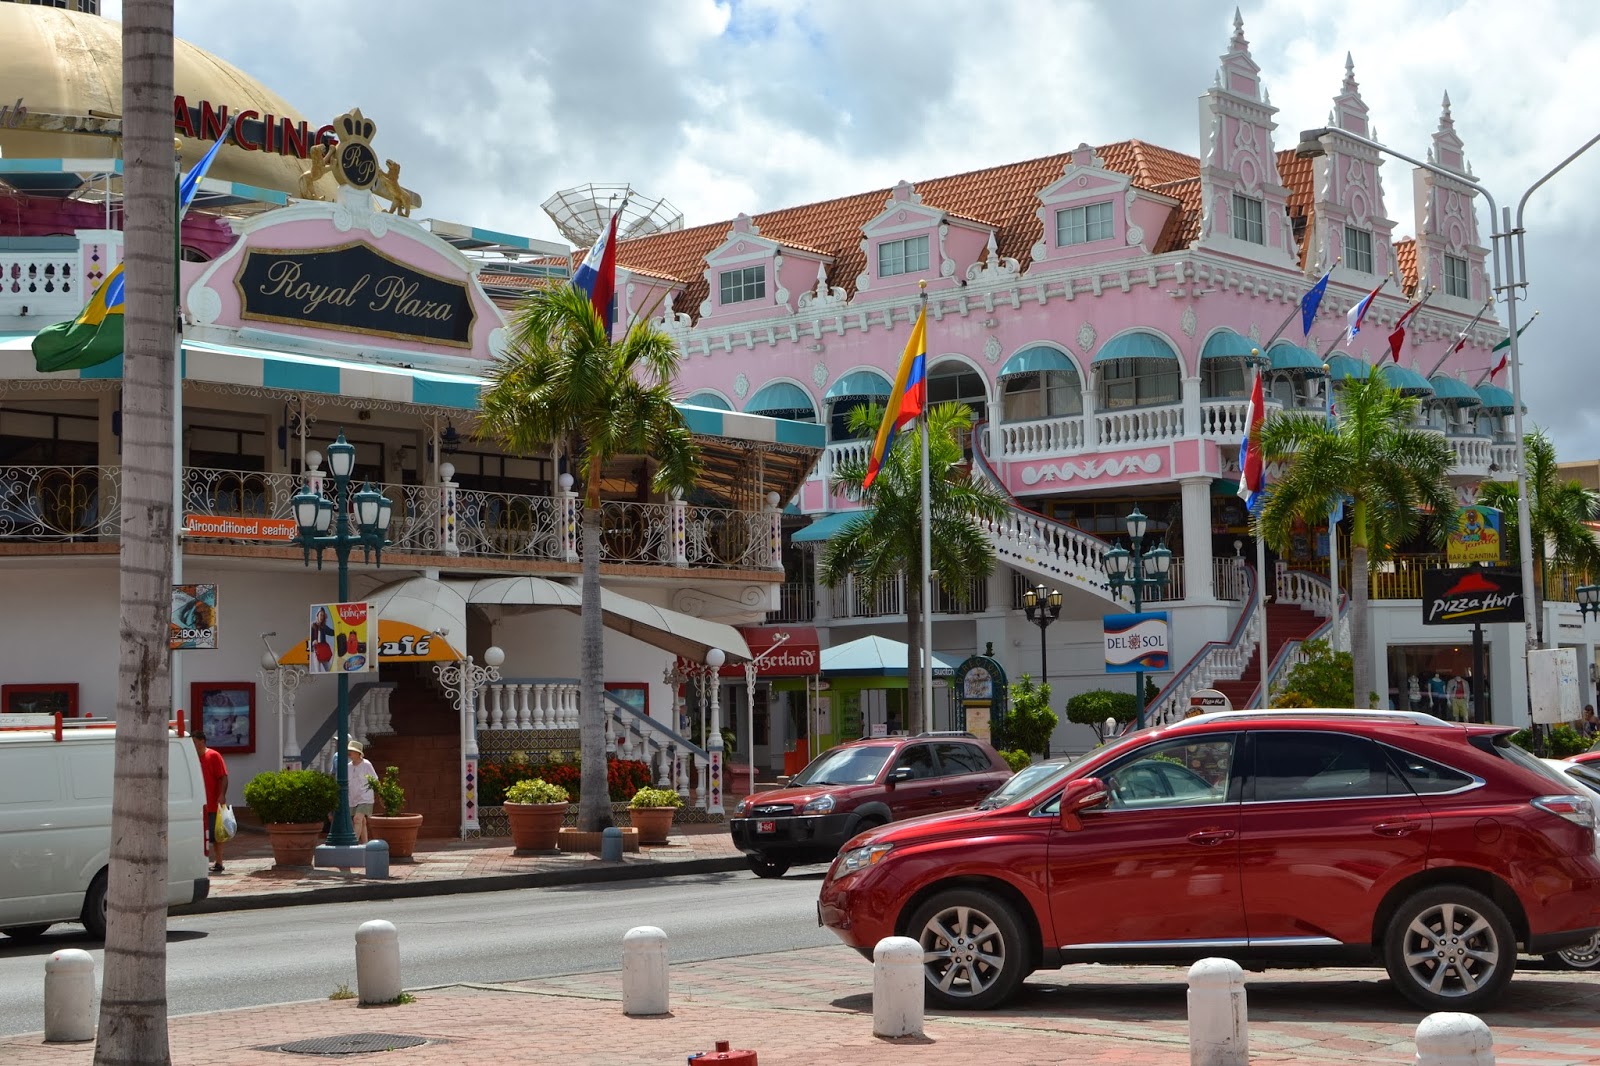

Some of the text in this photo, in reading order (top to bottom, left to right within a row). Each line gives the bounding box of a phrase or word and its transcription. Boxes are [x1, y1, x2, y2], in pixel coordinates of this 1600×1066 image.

[174, 95, 339, 163] ANCING
[259, 260, 453, 321] Royal Plaza
[189, 519, 298, 539] Airconditioned seating!
[1469, 552, 1498, 560] CANTINA
[340, 607, 359, 619] kipling
[1429, 592, 1520, 621] Pizza Hut
[377, 635, 431, 656] afé
[1107, 635, 1164, 649] DEL SOL
[752, 650, 816, 671] itzerland
[956, 658, 1002, 684] DIRECTORY
[934, 668, 955, 676] swatch
